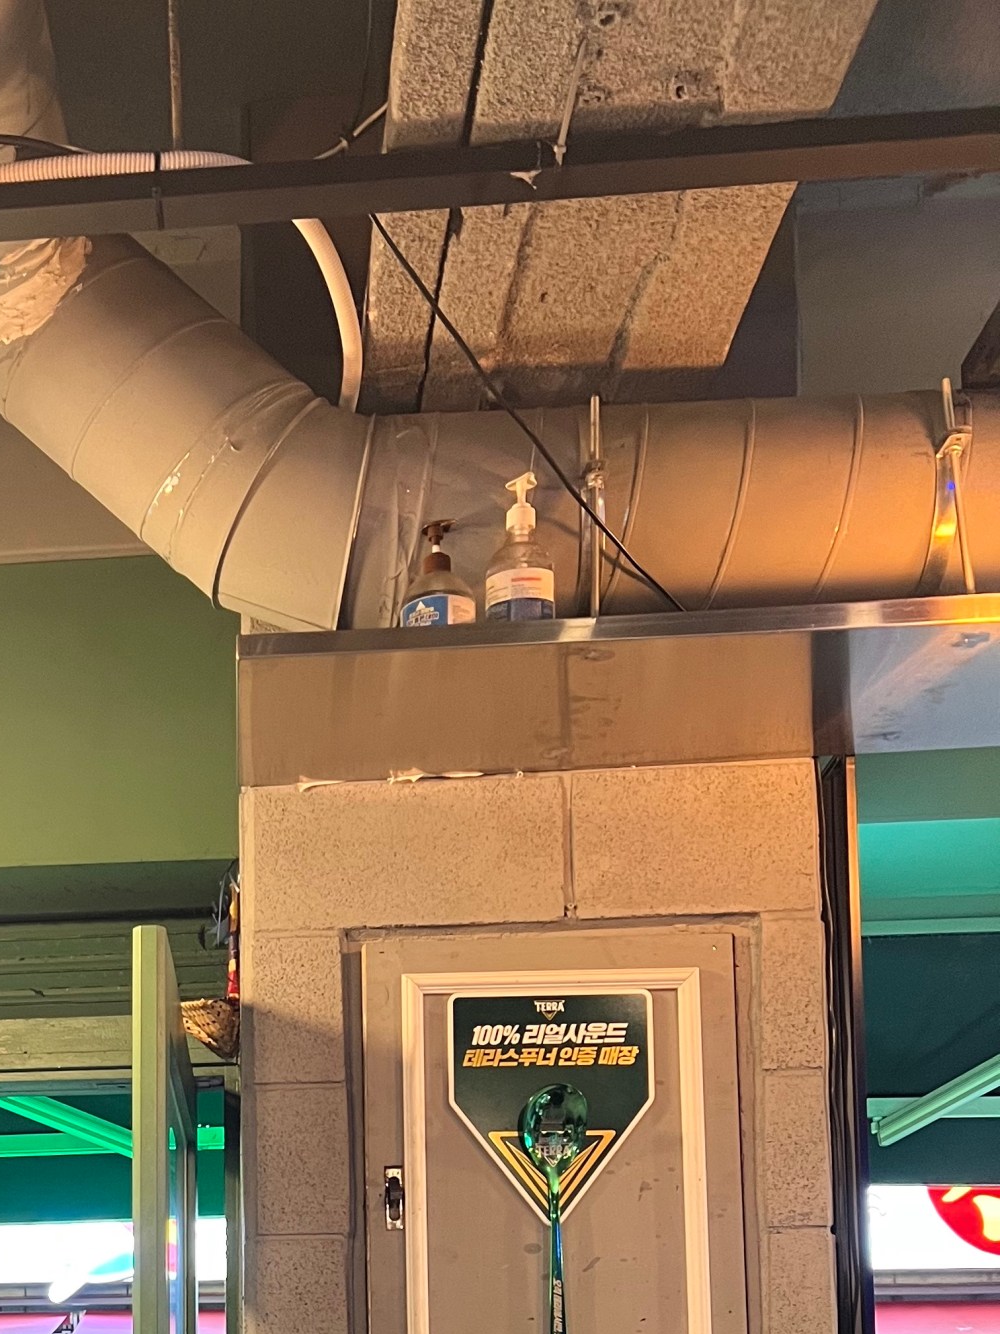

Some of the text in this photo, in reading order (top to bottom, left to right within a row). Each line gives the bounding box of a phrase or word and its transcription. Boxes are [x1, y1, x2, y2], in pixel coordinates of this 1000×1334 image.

[534, 1000, 565, 1012] TERRA
[471, 1022, 629, 1046] 100% 리얼사운드
[462, 1045, 640, 1067] 테라스푸너 인증 매장
[535, 1144, 572, 1156] TERRA
